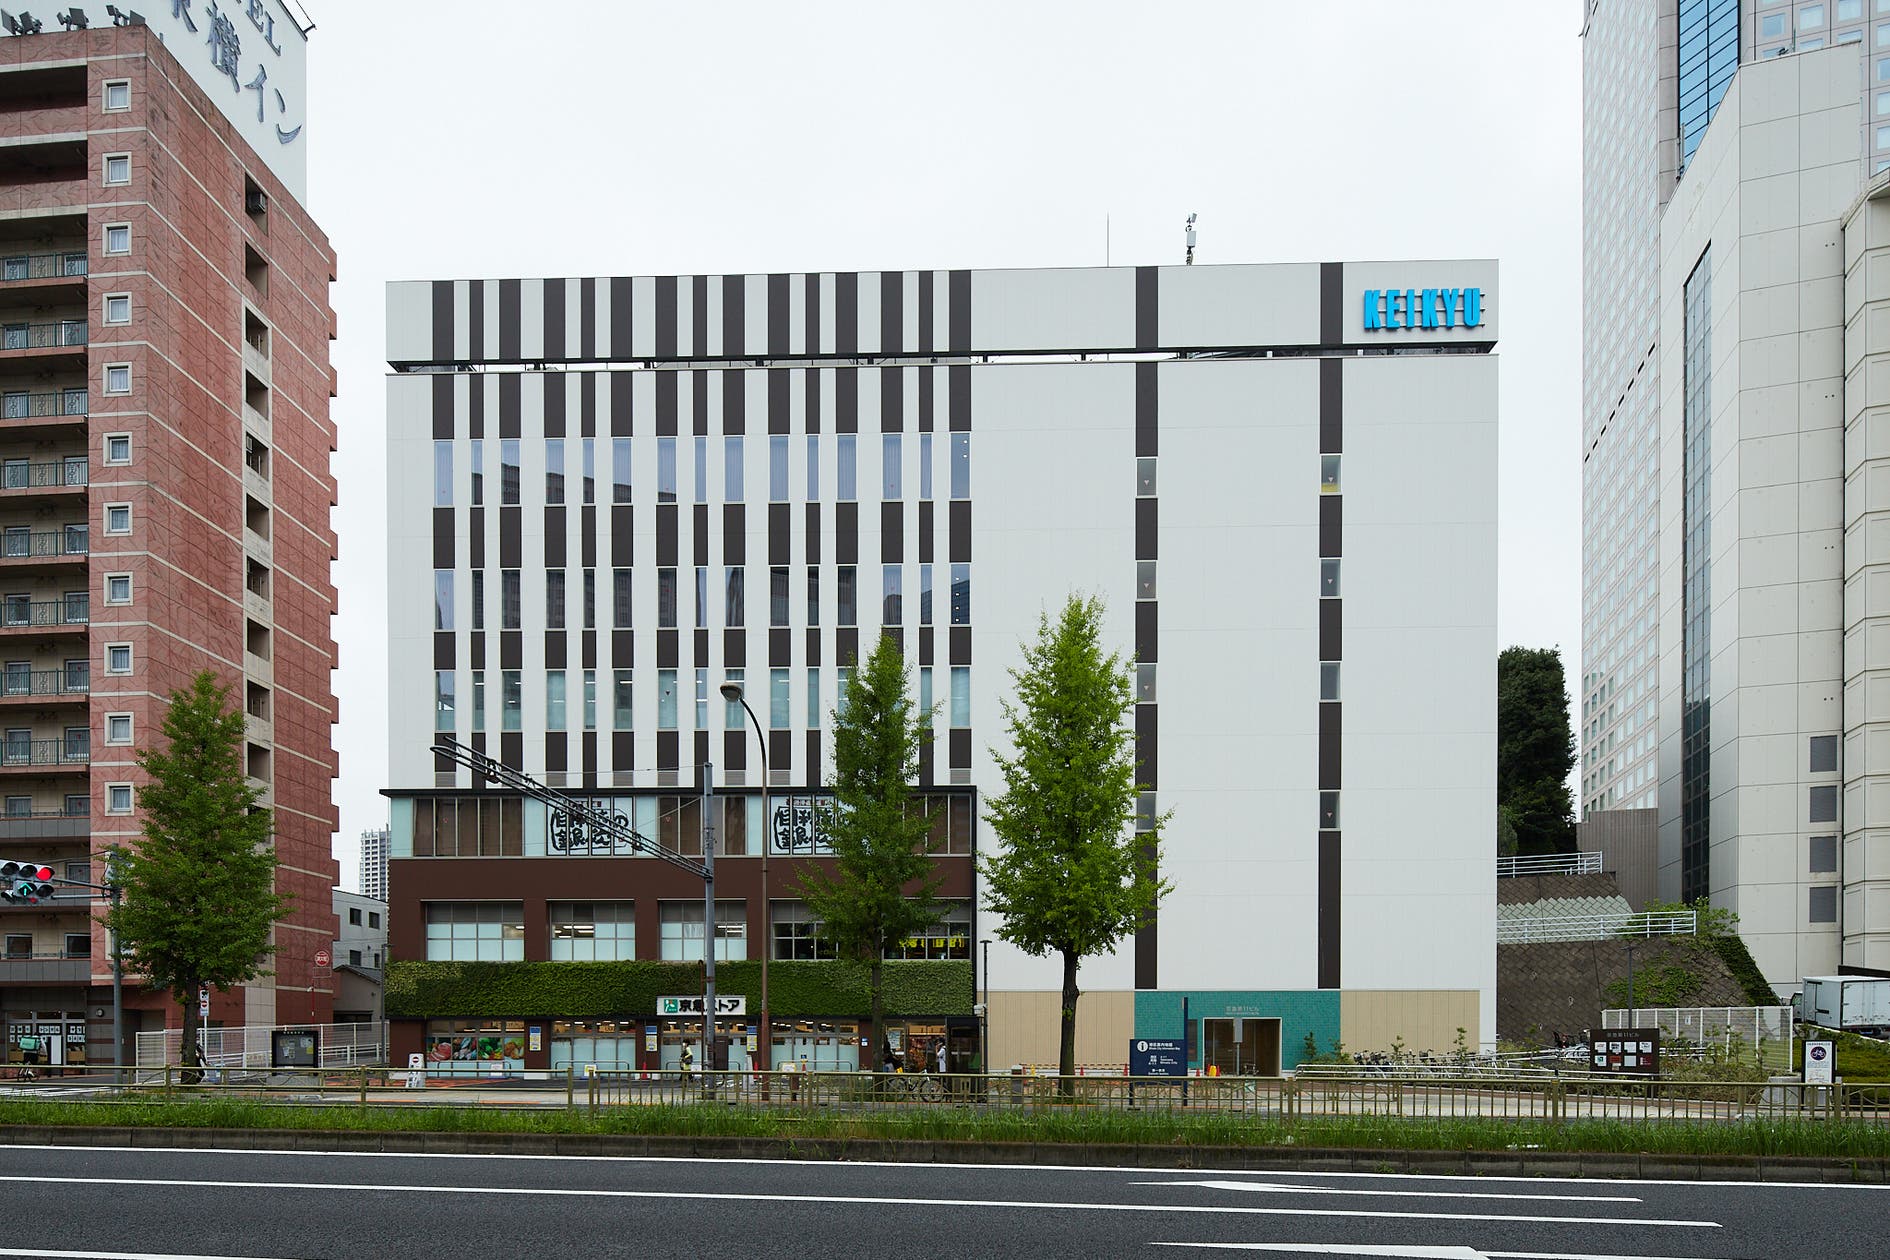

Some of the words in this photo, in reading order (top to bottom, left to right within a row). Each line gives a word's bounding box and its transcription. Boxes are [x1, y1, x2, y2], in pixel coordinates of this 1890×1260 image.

[235, 0, 281, 56] EL
[1363, 288, 1480, 330] KEIKYU
[679, 999, 740, 1012] 京急トア
